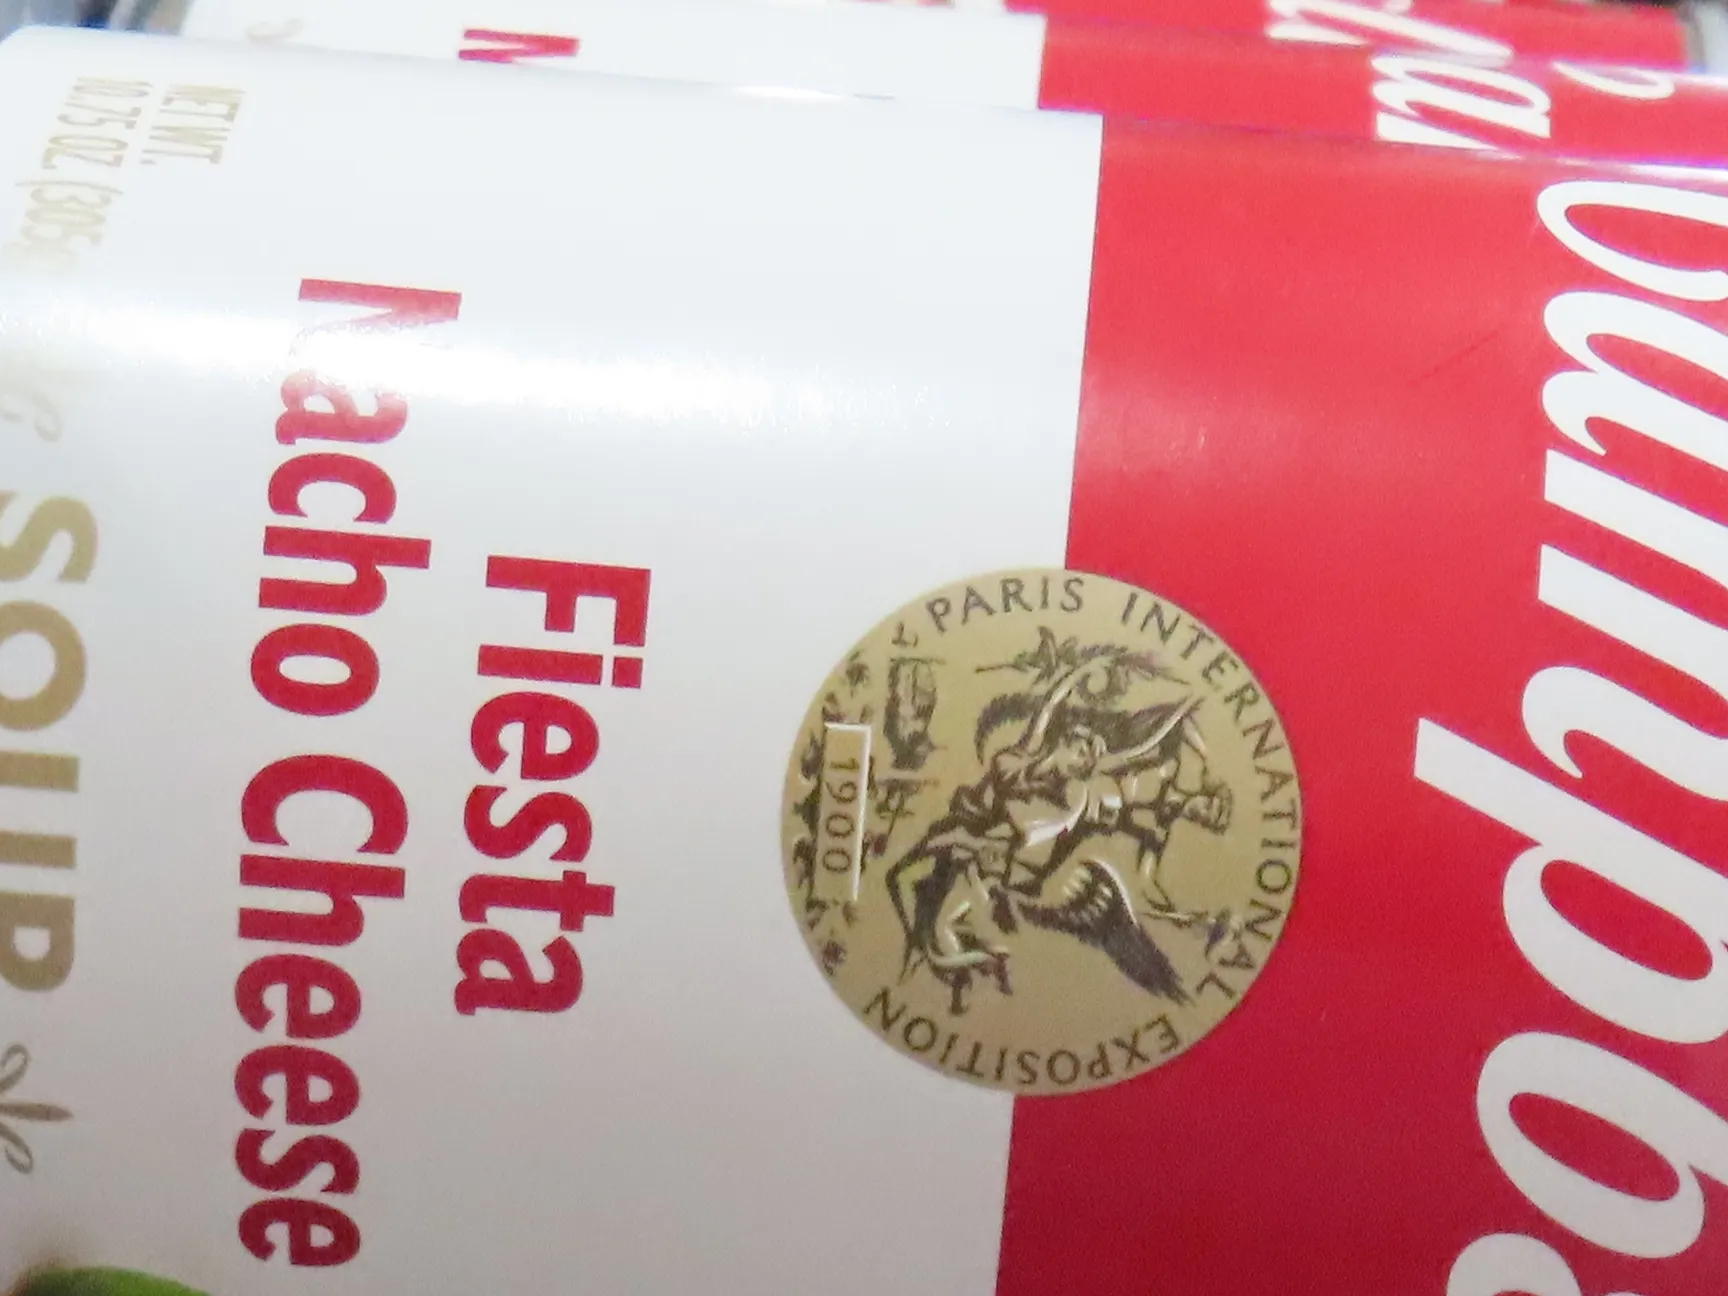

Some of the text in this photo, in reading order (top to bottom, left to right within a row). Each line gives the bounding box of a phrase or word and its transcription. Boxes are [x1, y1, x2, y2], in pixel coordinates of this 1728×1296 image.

[235, 753, 409, 1268] Cheese
[453, 554, 652, 1017] Fiesta
[821, 756, 860, 876] 1900
[863, 575, 1299, 1087] PARIS INTERNATIONAL EXPOSITION
